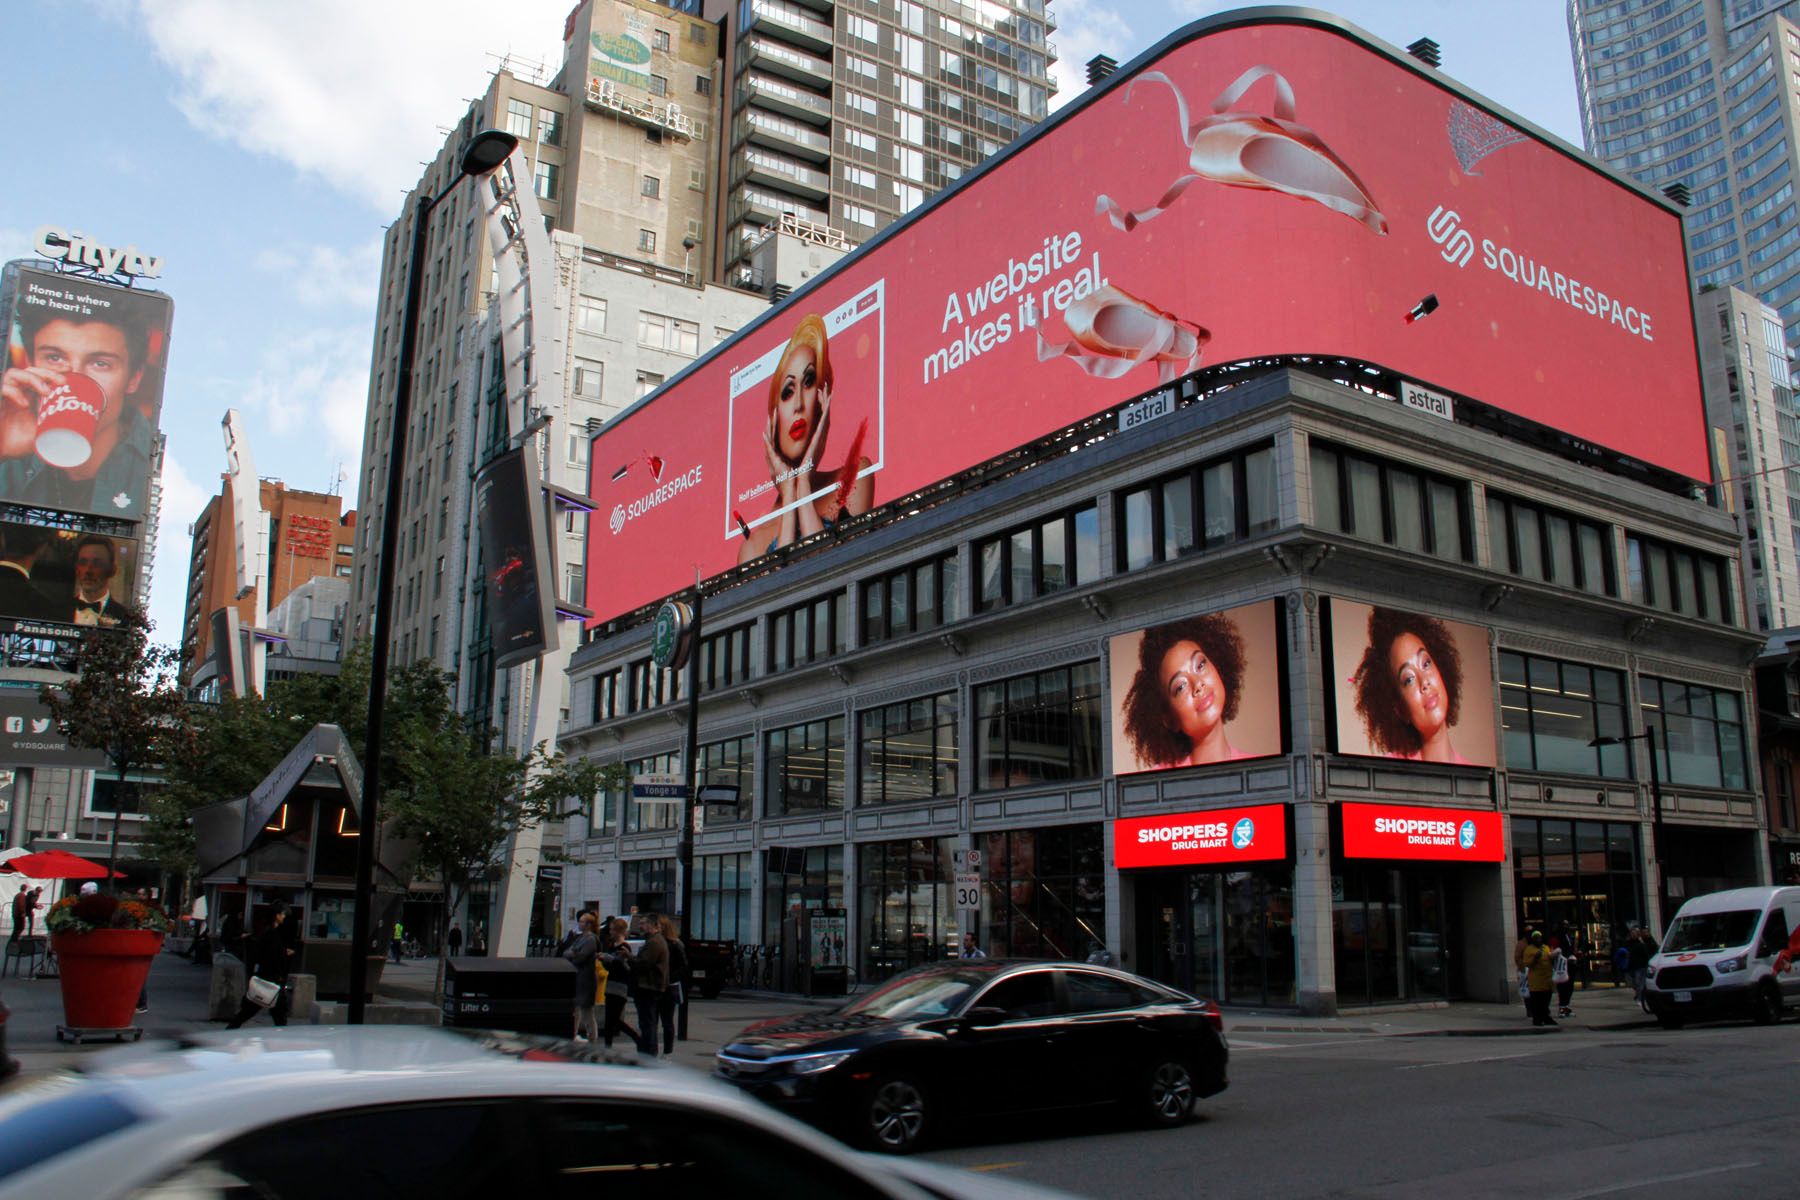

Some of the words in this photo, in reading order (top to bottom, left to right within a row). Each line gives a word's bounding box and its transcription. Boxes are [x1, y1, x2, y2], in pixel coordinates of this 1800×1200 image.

[34, 224, 165, 278] Citytv
[942, 292, 964, 333] A
[967, 231, 1082, 317] website
[1482, 239, 1654, 341] SQUARESPACE
[26, 295, 46, 305] the
[49, 298, 80, 313] heart
[82, 305, 92, 315] is
[29, 283, 62, 298] Home
[65, 290, 74, 301] is
[76, 294, 111, 308] where
[924, 312, 1012, 384] makes
[1018, 293, 1036, 332] it
[1043, 251, 1109, 319] real.
[1126, 395, 1167, 426] astral
[1409, 390, 1447, 415] astral
[628, 464, 702, 520] SQUARESPACE
[14, 622, 81, 638] Panasonic
[656, 620, 668, 645] P
[644, 786, 670, 797] Yonge
[1138, 822, 1228, 843] SHOPPERS
[1375, 818, 1456, 836] SHOPPERS
[1171, 840, 1198, 850] DRUG
[1199, 838, 1228, 848] MART
[1408, 835, 1432, 845] DRUG
[1433, 836, 1456, 845] MART
[958, 889, 978, 905] 30
[461, 1002, 479, 1012] Litter
